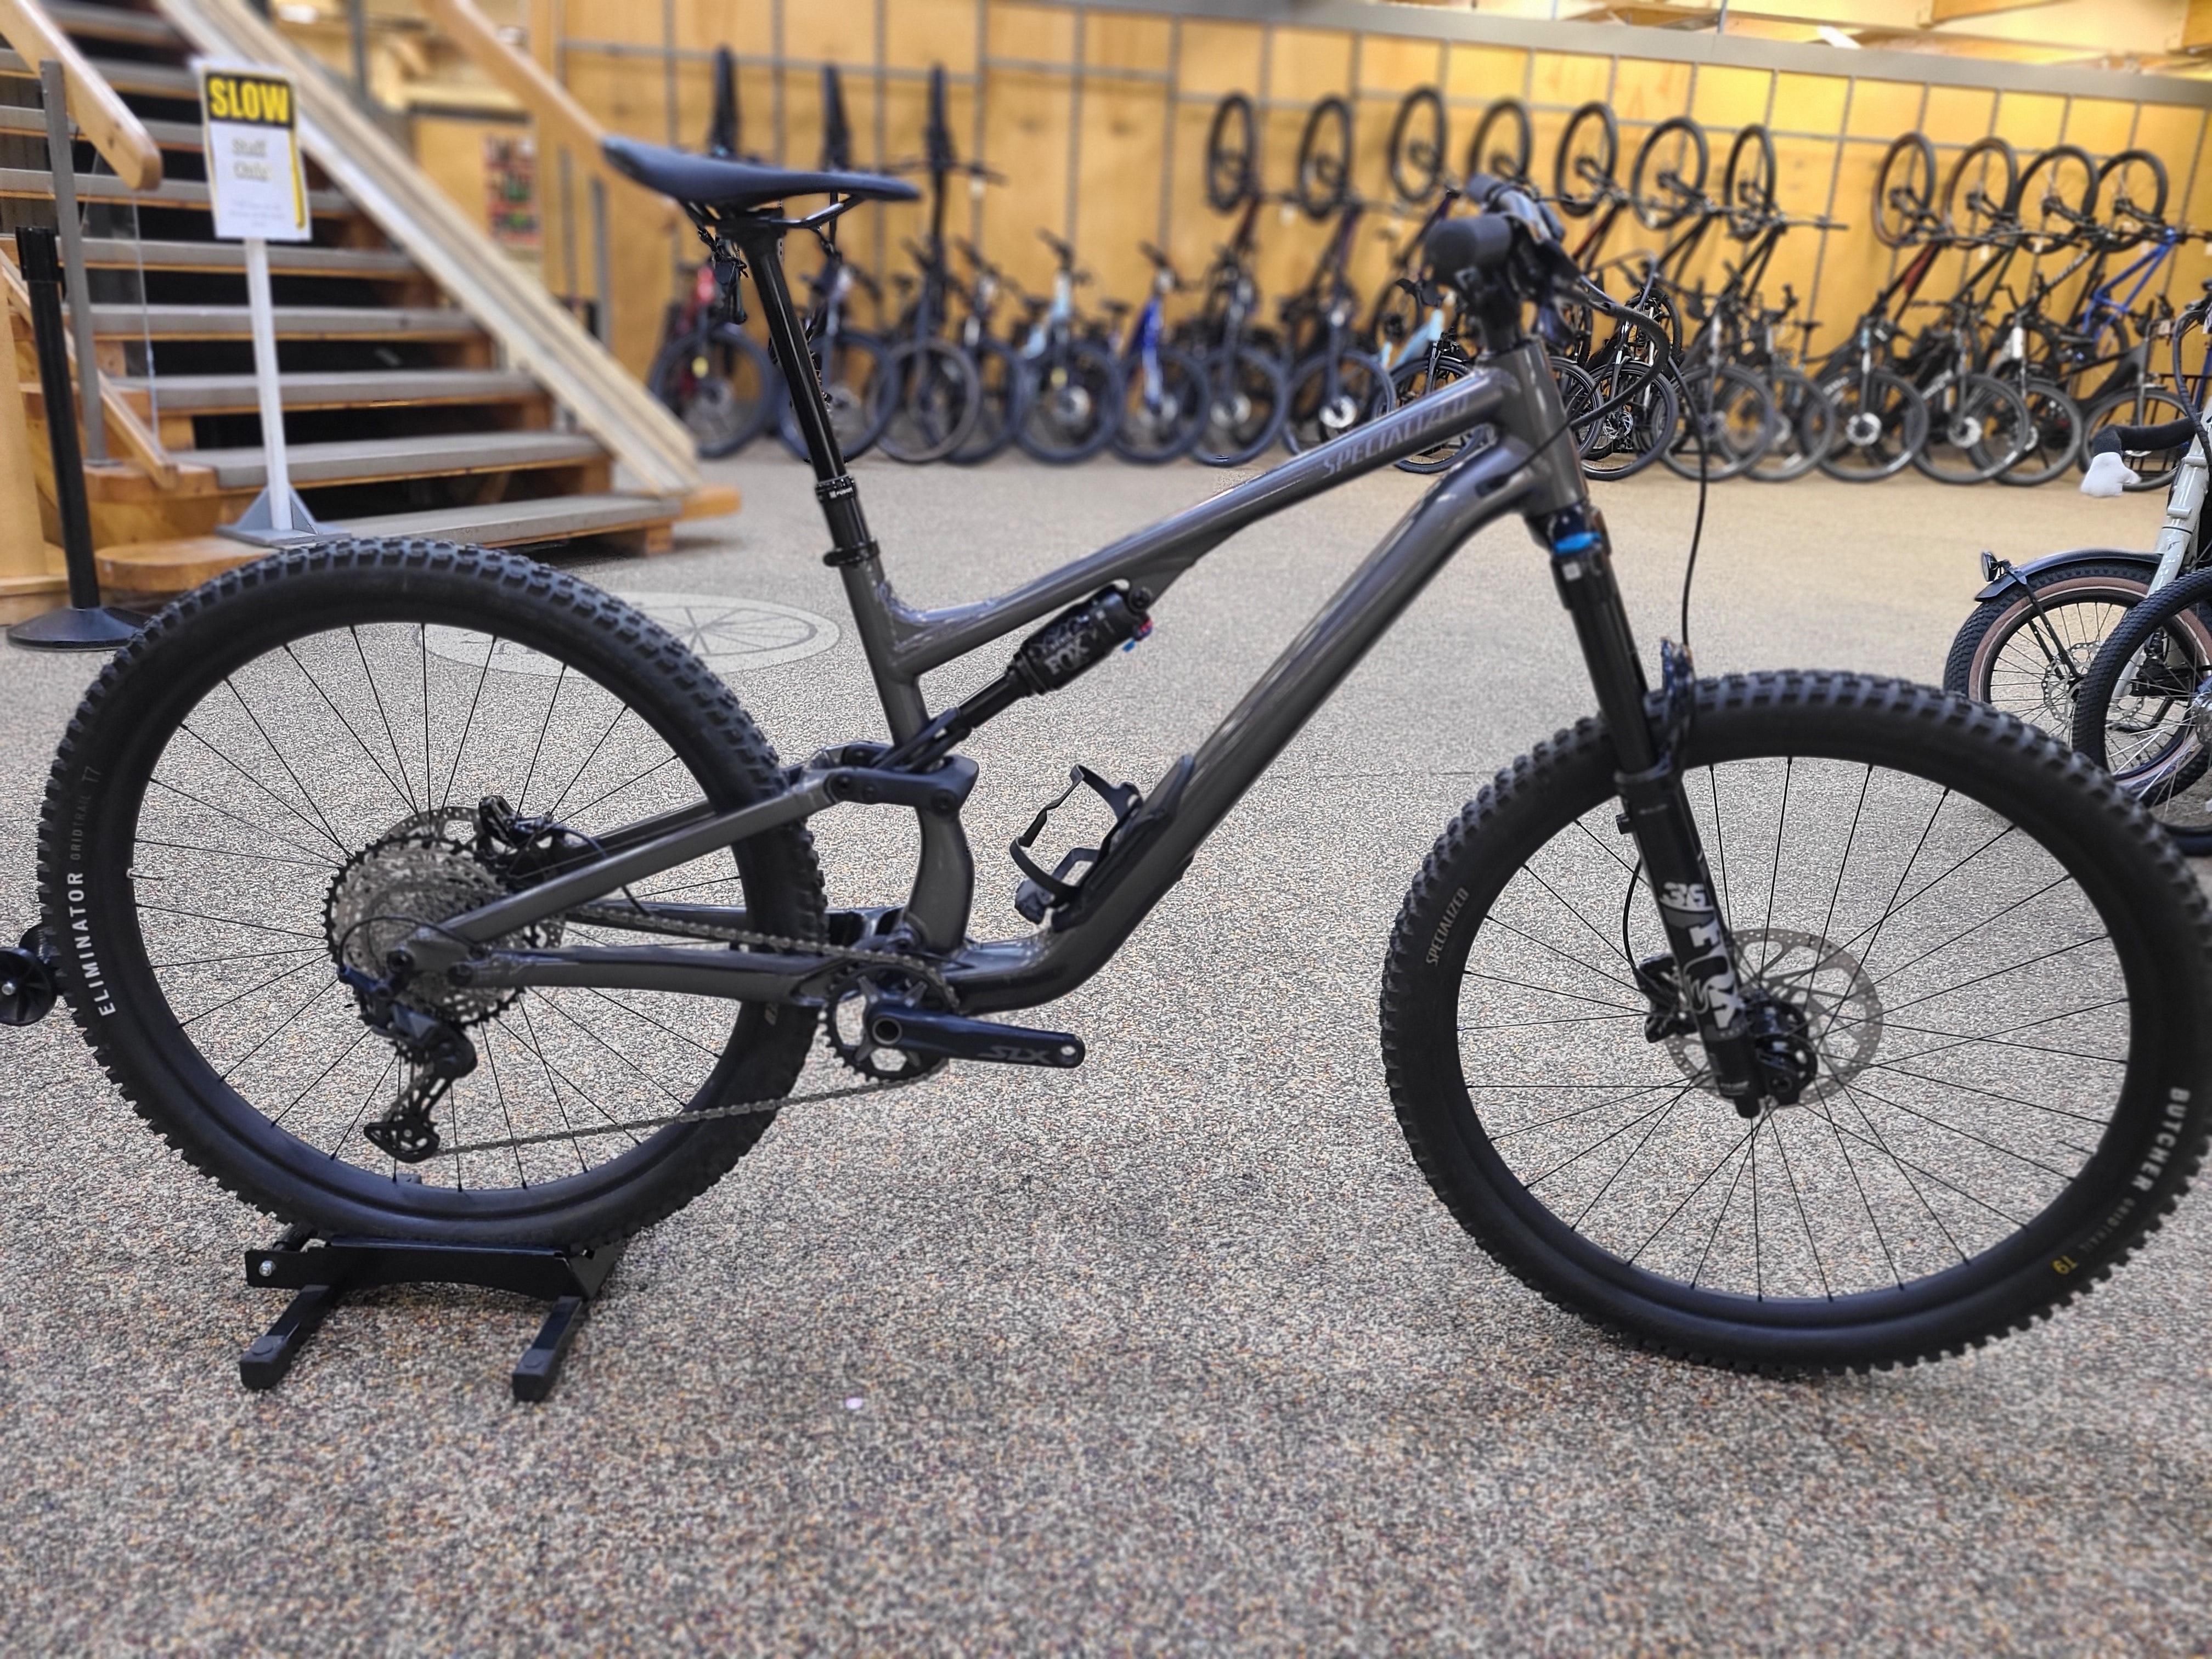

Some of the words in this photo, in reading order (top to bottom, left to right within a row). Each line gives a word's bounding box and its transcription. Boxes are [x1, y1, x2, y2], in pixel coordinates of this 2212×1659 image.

[208, 77, 289, 123] SLOW
[1045, 634, 1089, 675] FOX
[82, 765, 101, 784] T7
[1660, 882, 1707, 908] 36
[66, 872, 116, 1016] ELIMINATOR
[1426, 887, 1470, 967] SPECIALIZED
[978, 1046, 1053, 1065] SLX
[2132, 1087, 2191, 1192] BUTCHER
